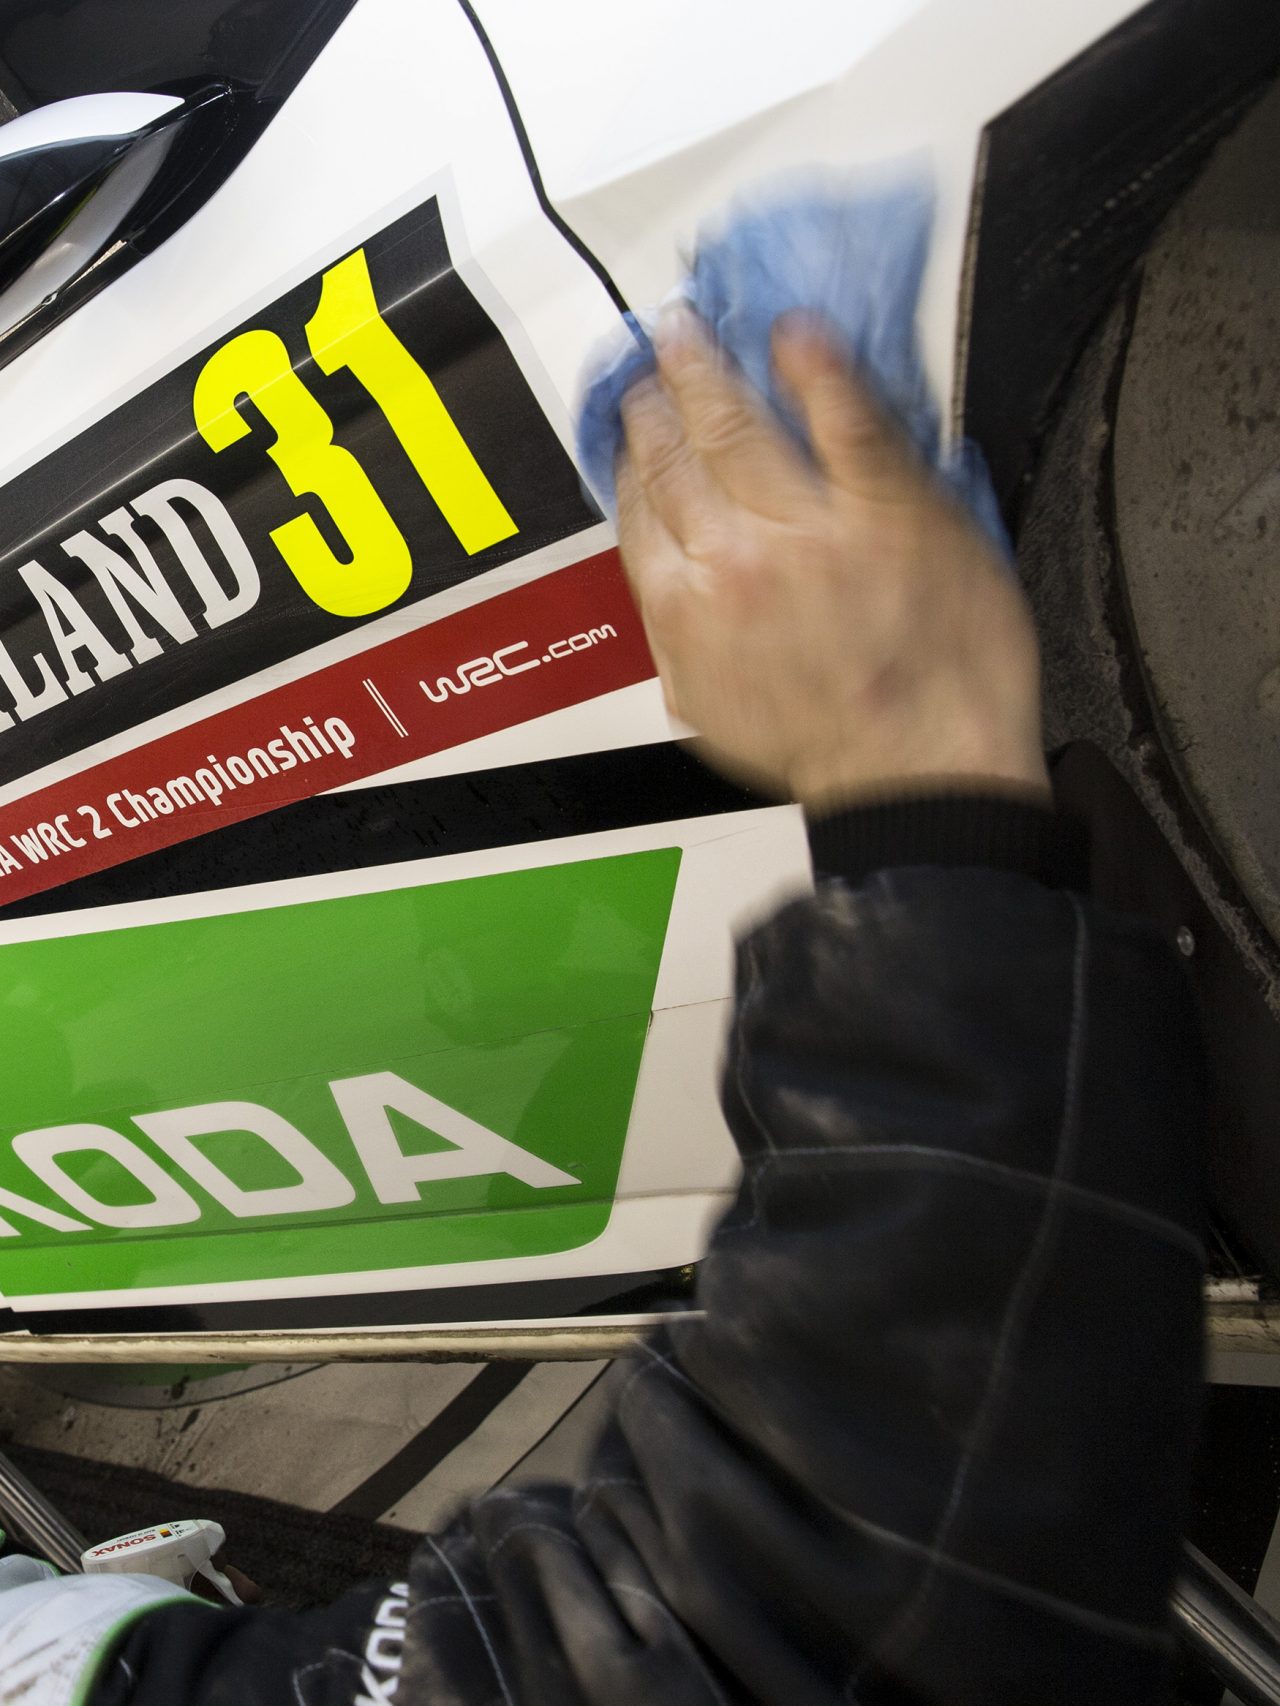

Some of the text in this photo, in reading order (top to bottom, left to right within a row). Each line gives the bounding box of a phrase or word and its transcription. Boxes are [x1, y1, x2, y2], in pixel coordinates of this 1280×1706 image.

[192, 247, 519, 617] 31
[10, 814, 87, 864] WRC
[76, 804, 113, 840] 2
[106, 716, 356, 830] Championship
[92, 1534, 157, 1557] SONAX
